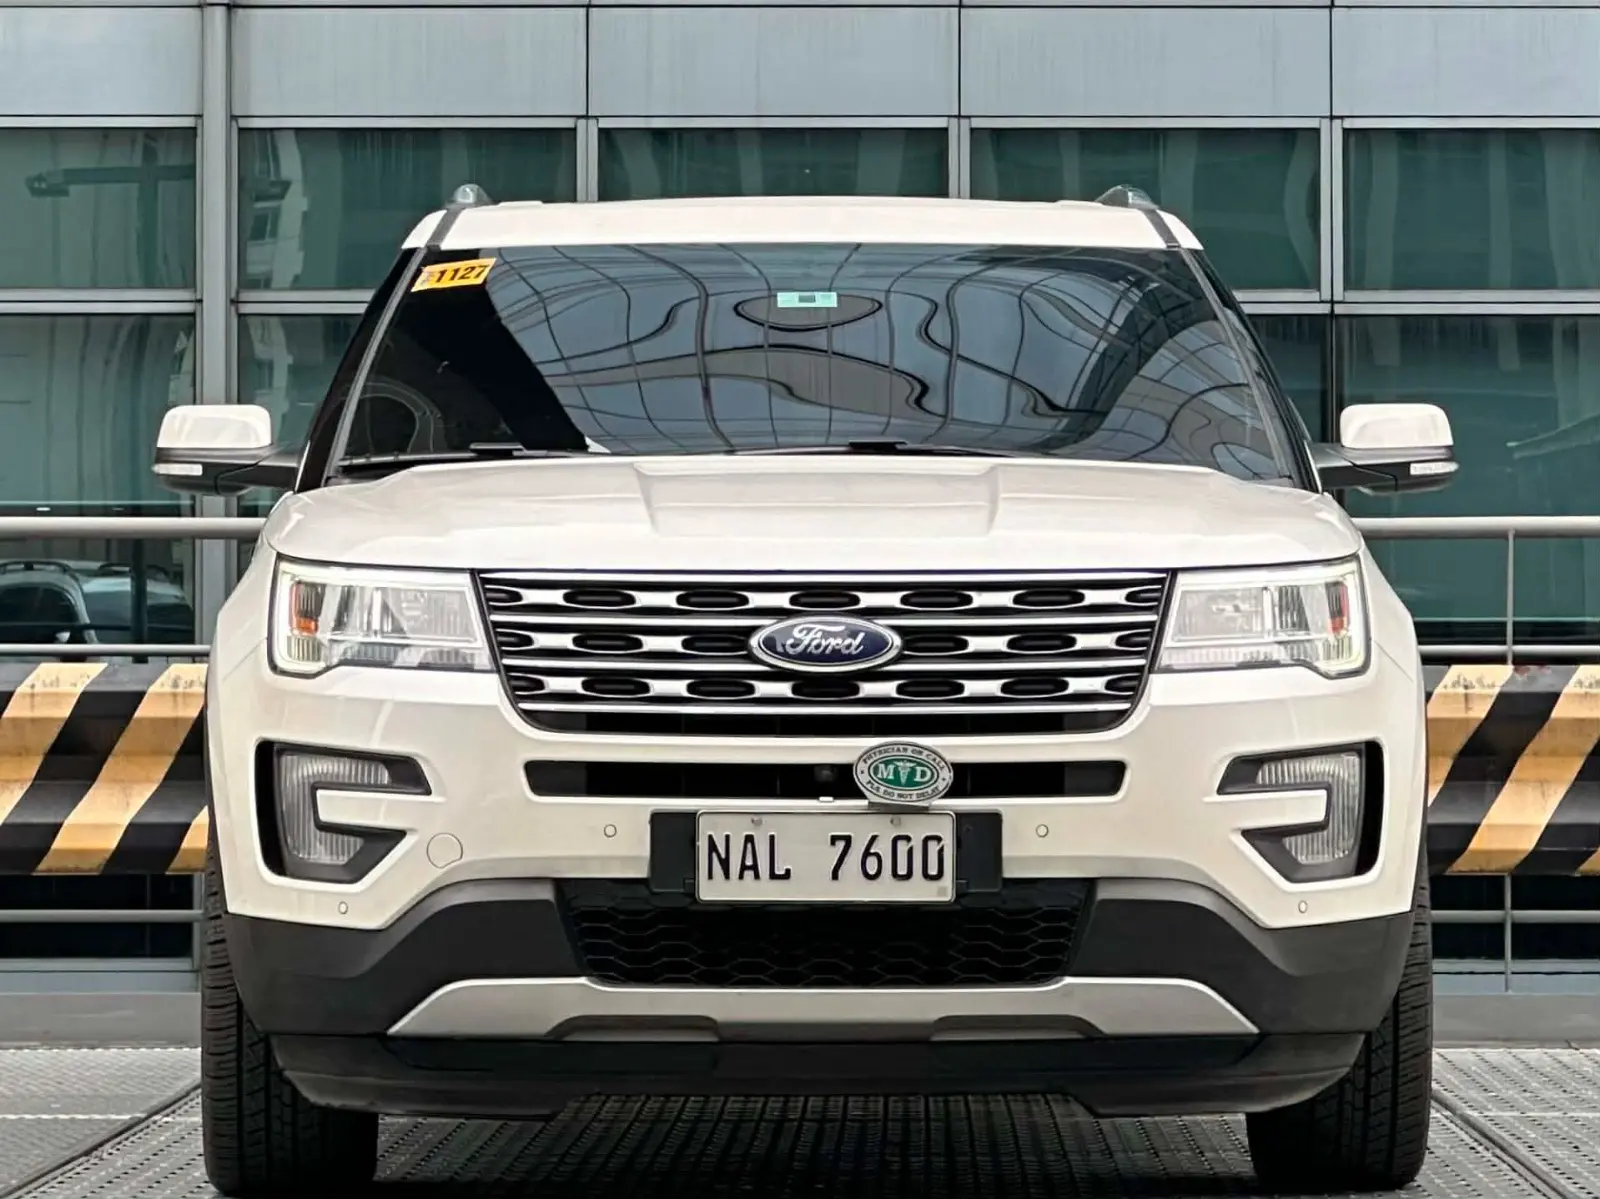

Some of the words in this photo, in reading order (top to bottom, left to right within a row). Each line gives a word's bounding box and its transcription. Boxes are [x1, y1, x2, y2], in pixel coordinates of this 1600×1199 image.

[436, 265, 489, 283] 1127
[785, 624, 866, 655] Ford
[862, 746, 909, 765] PHYSICIAN
[926, 754, 945, 772] CALL
[707, 834, 791, 880] NAL
[829, 834, 945, 881] 7600
